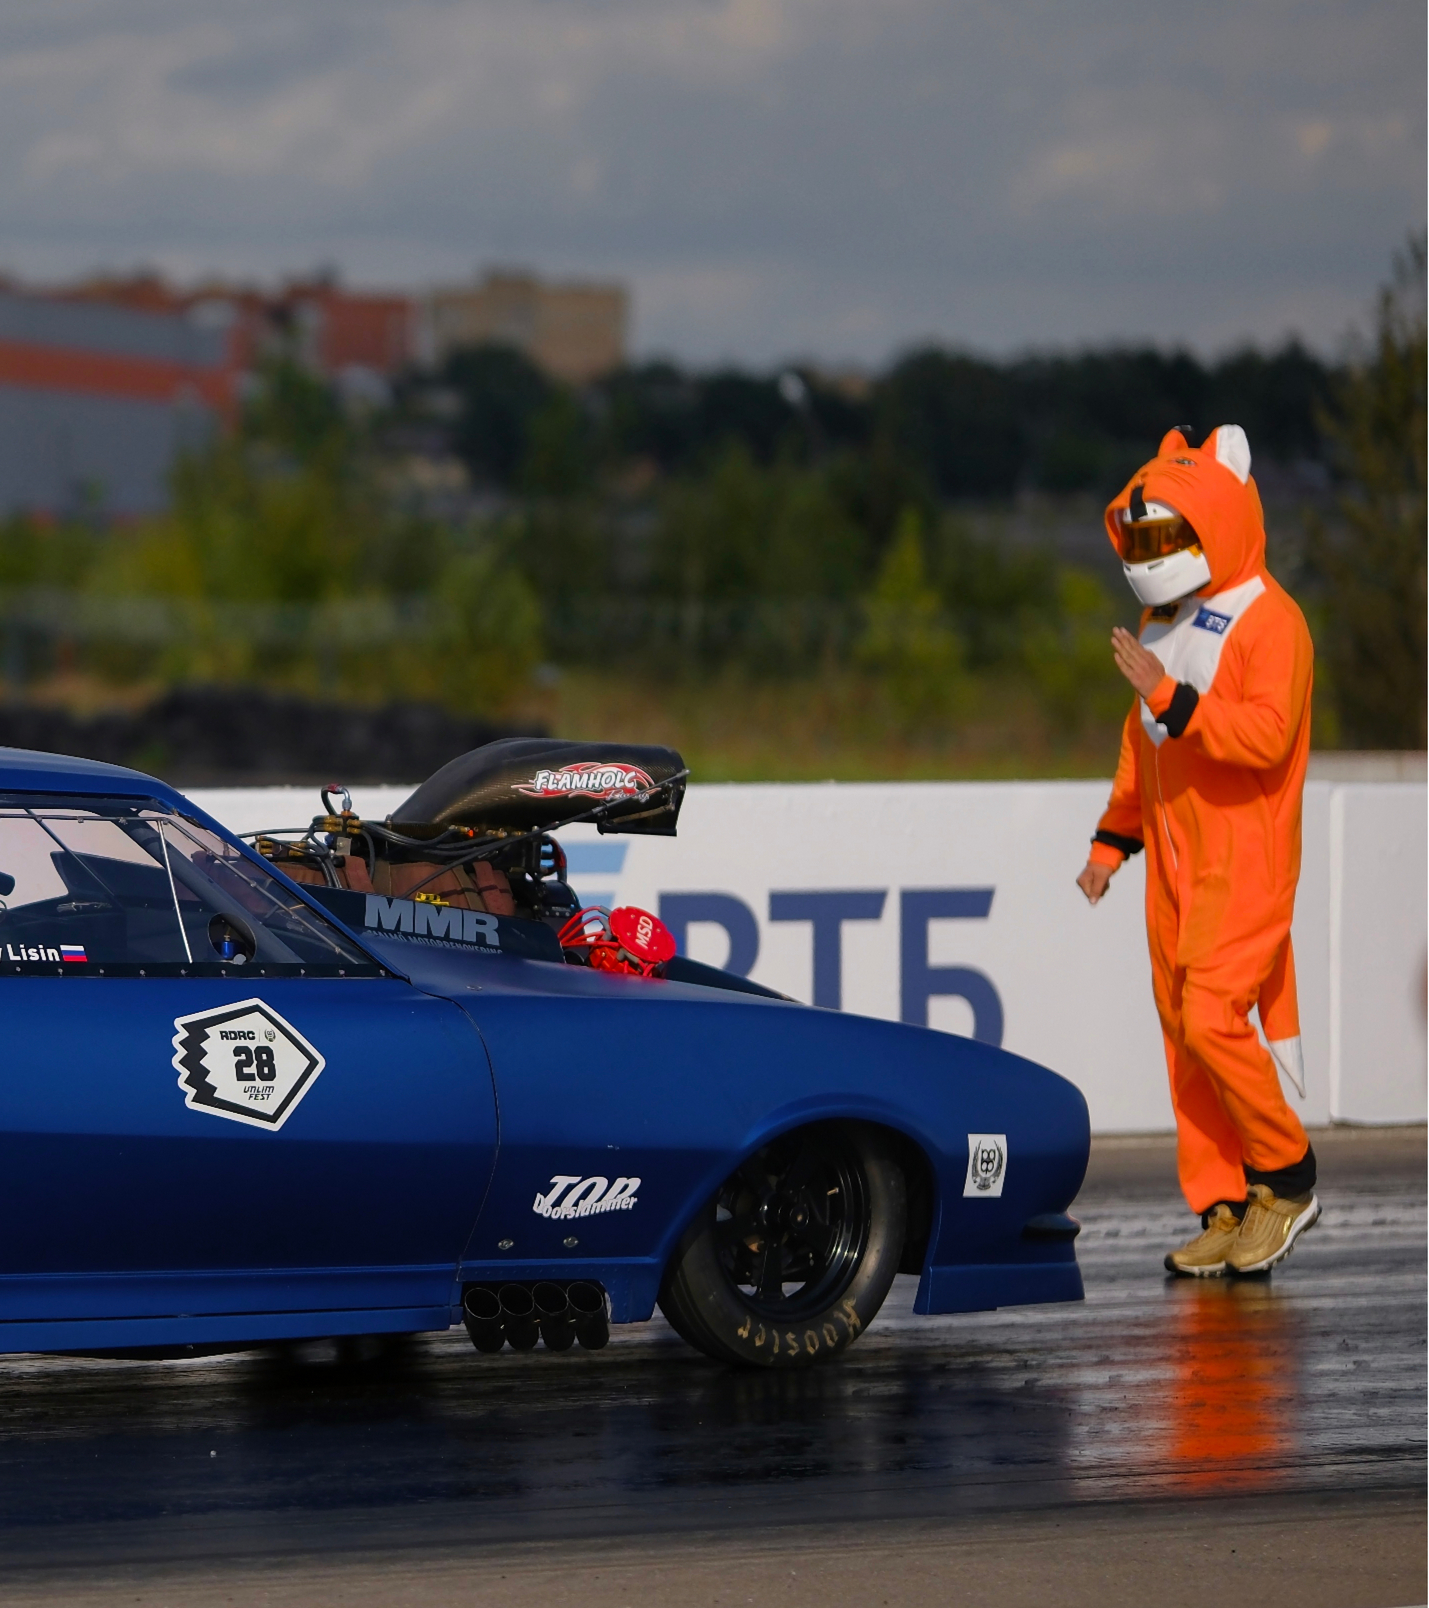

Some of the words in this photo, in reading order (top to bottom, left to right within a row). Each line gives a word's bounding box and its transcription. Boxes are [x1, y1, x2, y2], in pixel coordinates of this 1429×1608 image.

[534, 770, 637, 791] FLAMHOLC
[364, 893, 500, 946] MMR
[635, 915, 654, 950] MSD
[6, 943, 60, 962] Lisin
[219, 1030, 256, 1041] RDRC
[232, 1046, 276, 1081] 28
[248, 1093, 271, 1101] FEST
[544, 1175, 642, 1206] TOP
[532, 1192, 637, 1219] Doorslammer
